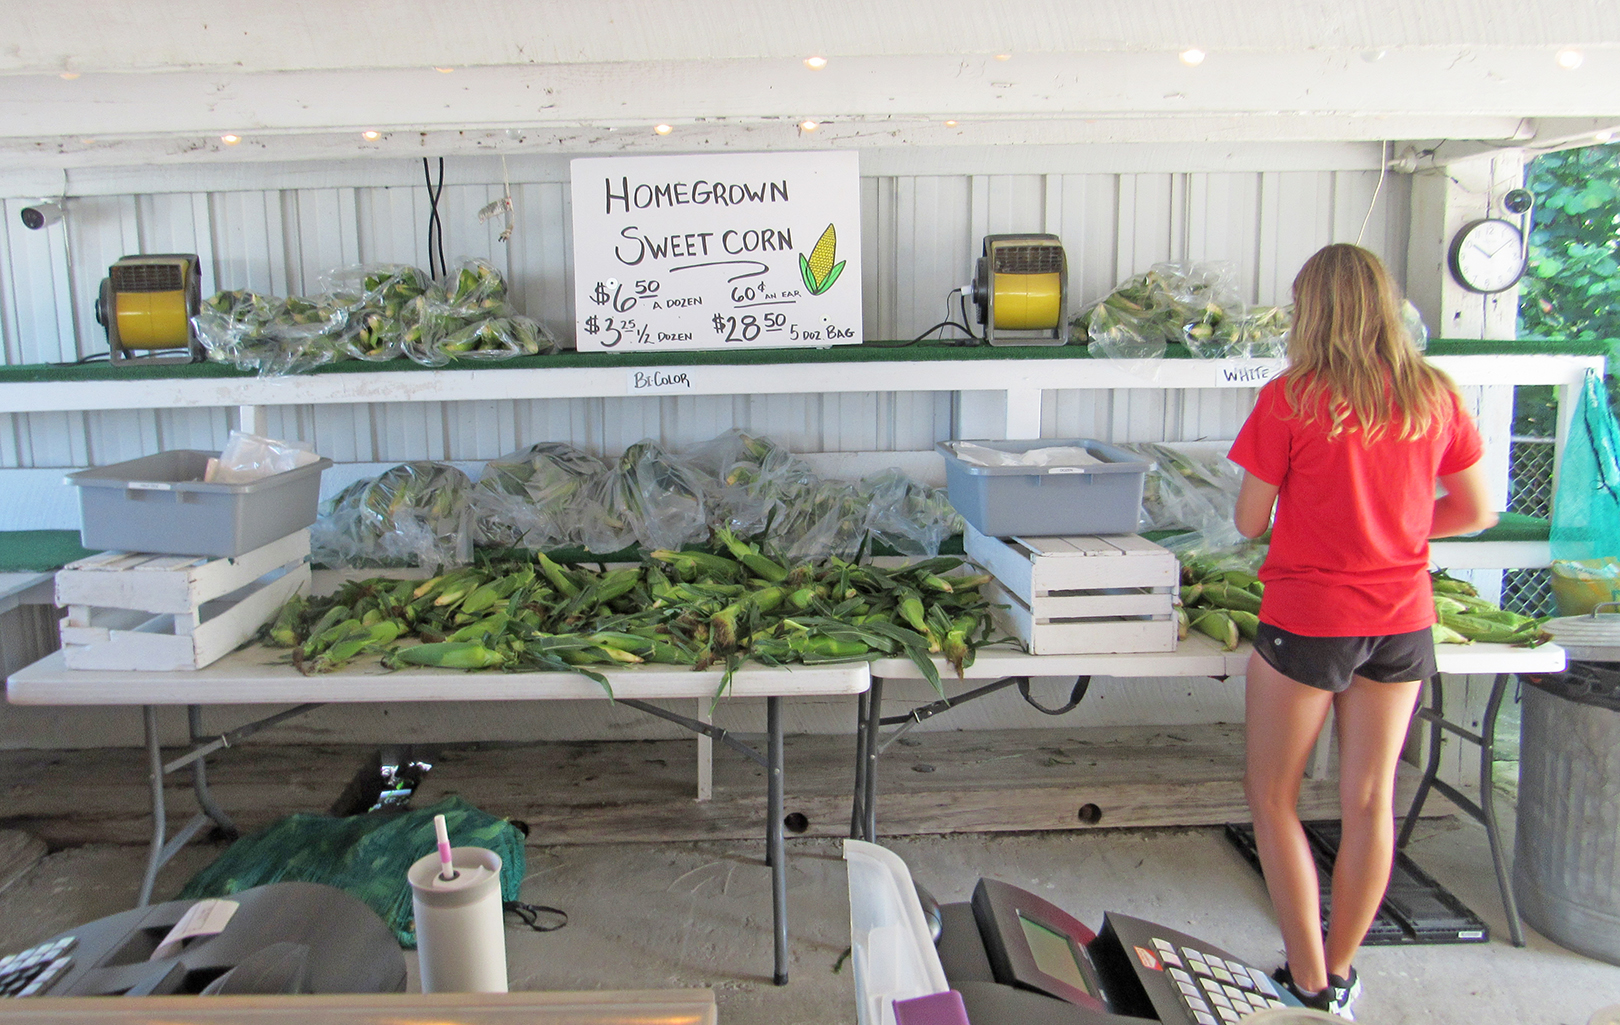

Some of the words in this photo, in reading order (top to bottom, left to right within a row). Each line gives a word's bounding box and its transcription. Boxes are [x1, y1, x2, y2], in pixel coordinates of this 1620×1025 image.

[605, 176, 789, 214] HOMEGROWN
[615, 226, 714, 265] SWEET
[722, 228, 793, 255] CORN
[652, 301, 663, 310] A
[666, 296, 703, 308] DOZEN
[765, 292, 777, 300] AN
[781, 290, 802, 298] EAR
[637, 323, 655, 344] 1/2
[657, 331, 693, 342] DOZEN
[790, 324, 800, 341] 5
[825, 324, 856, 340] BAG
[1223, 365, 1269, 381] WHITE
